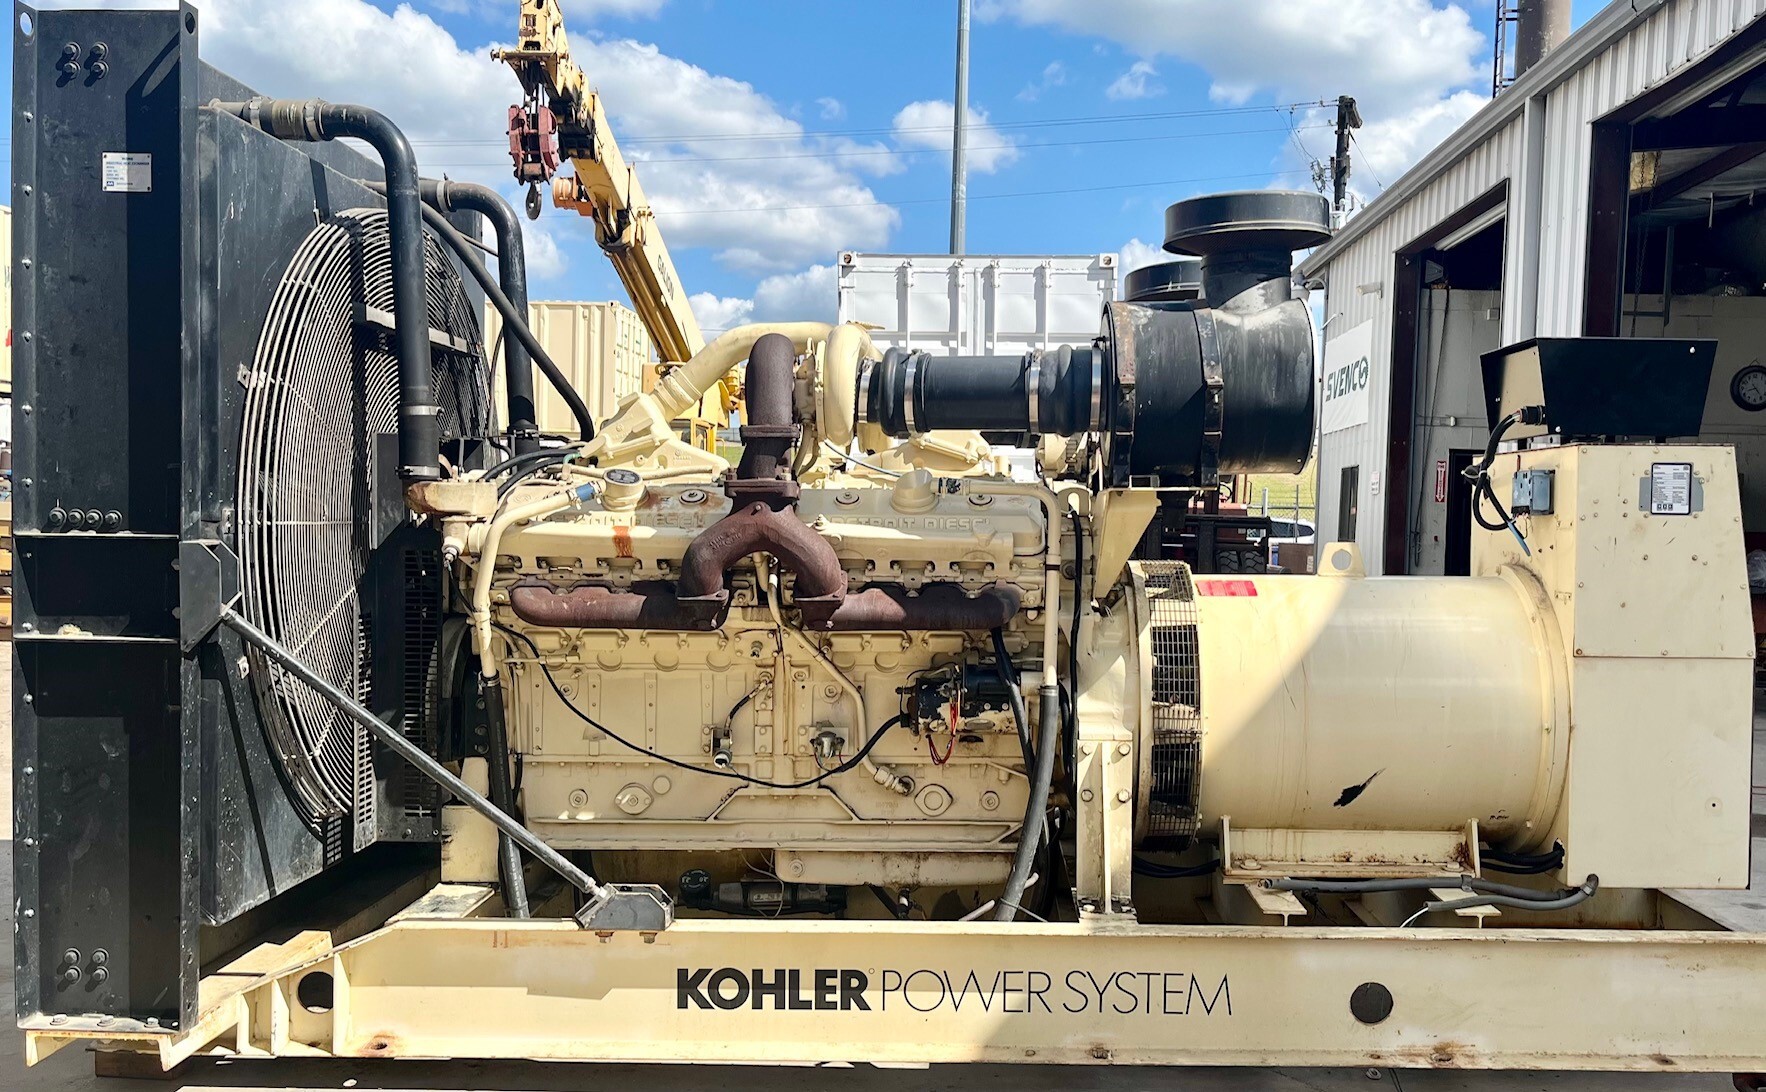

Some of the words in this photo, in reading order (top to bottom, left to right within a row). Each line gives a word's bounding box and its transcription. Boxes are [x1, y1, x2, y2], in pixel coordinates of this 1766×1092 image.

[1325, 355, 1369, 402] SVENCO
[677, 968, 872, 1010] KOHLER
[883, 969, 1053, 1012] POWER
[1063, 970, 1232, 1015] SYSTEM
